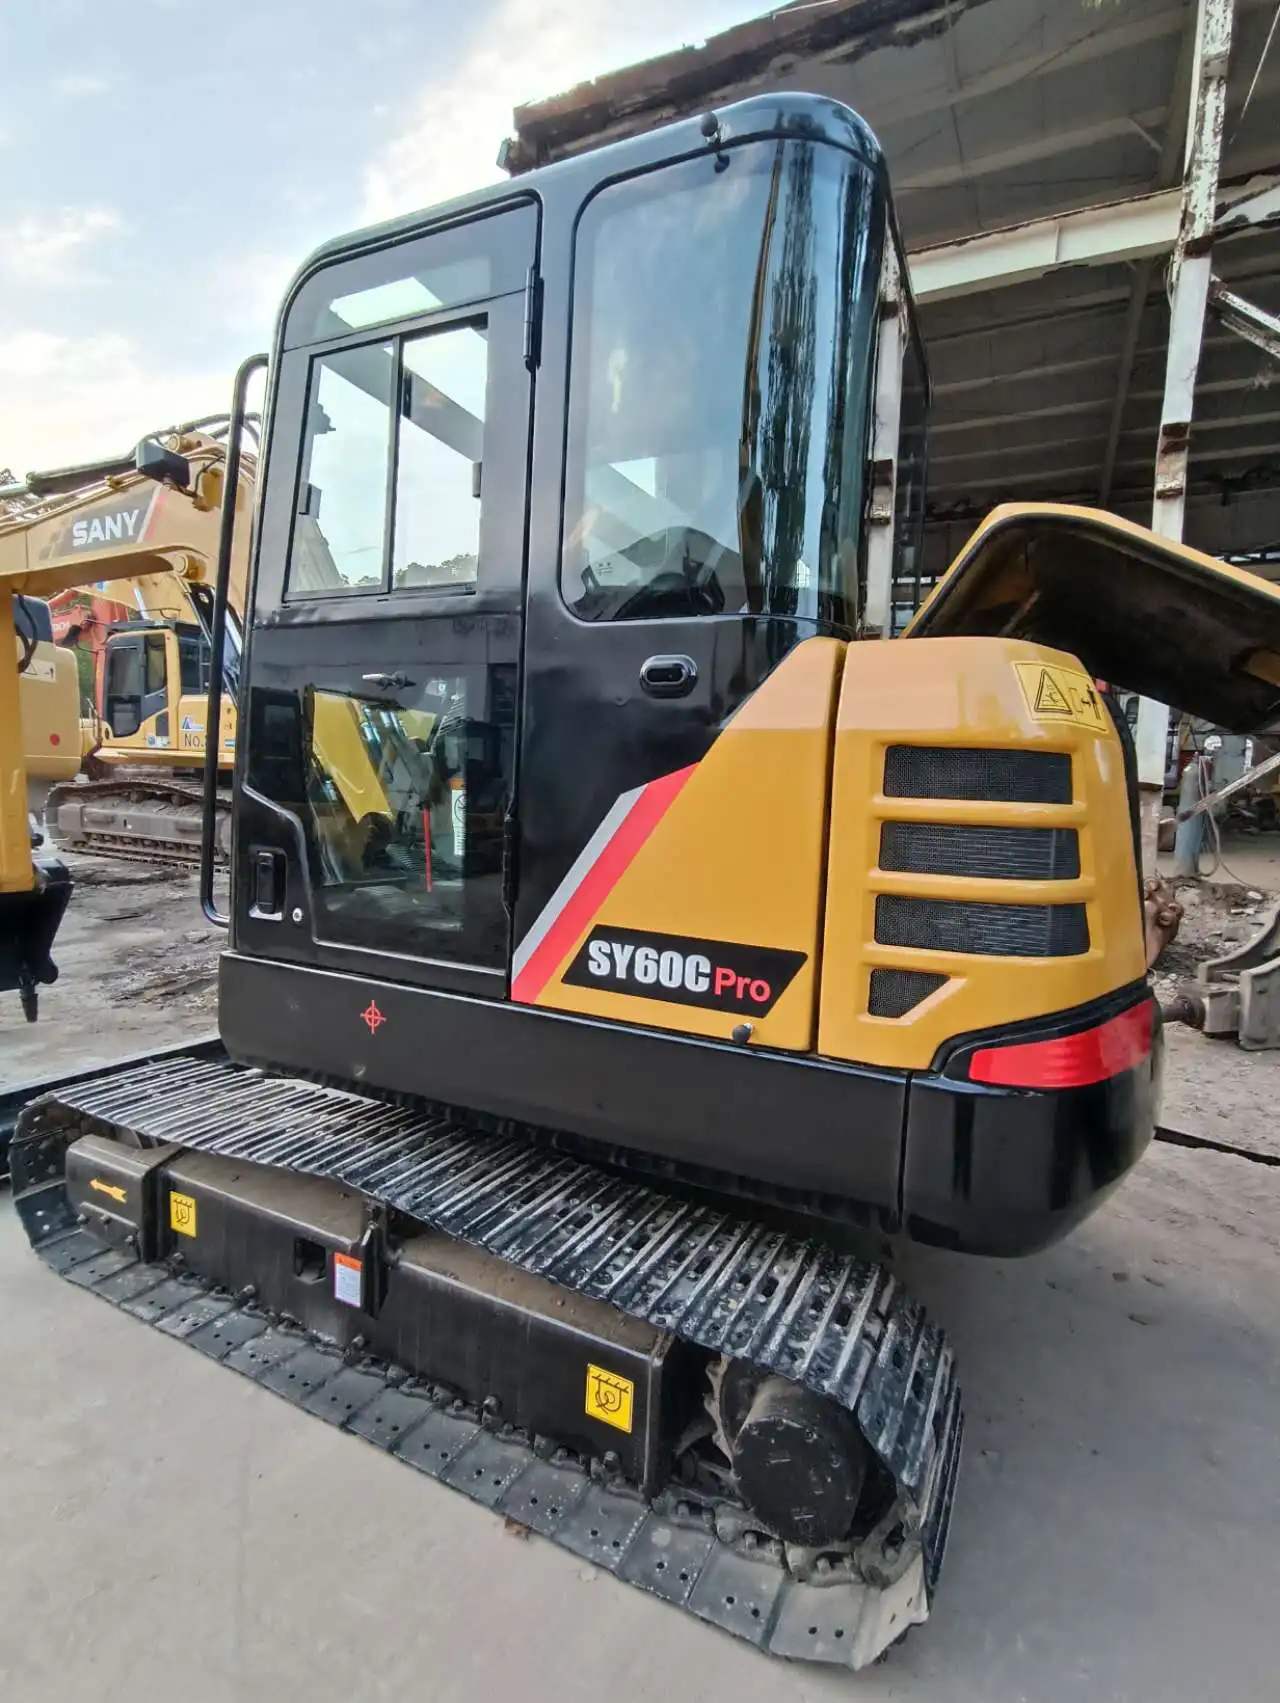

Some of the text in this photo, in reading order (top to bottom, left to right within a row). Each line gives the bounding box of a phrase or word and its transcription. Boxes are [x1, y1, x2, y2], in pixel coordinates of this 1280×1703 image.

[73, 509, 139, 546] SANY
[588, 939, 772, 1002] SY60C Pro
